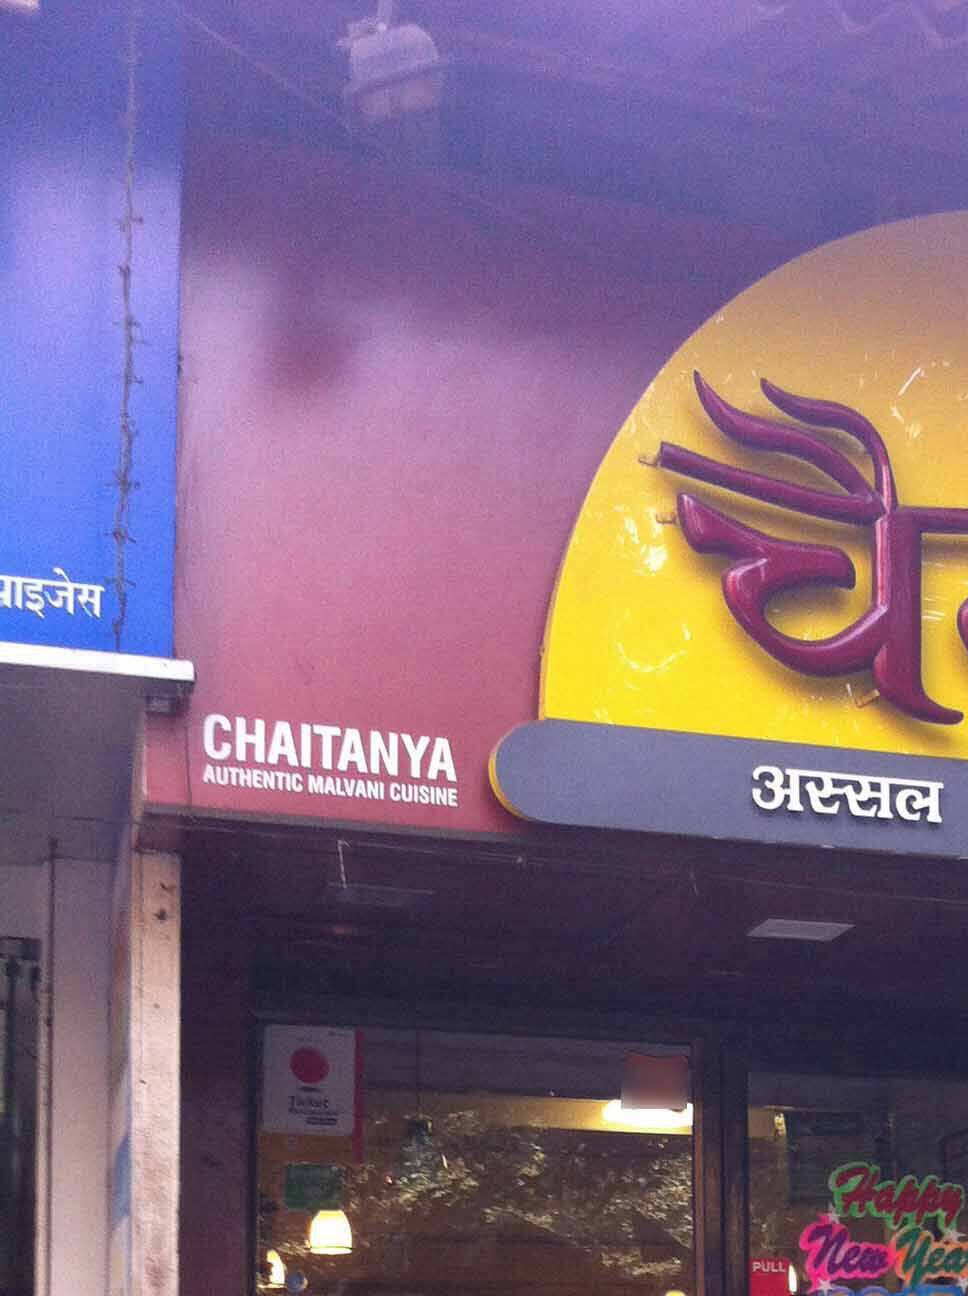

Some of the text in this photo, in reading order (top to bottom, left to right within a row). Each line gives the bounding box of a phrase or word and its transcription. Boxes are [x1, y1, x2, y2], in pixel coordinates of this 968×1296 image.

[202, 712, 458, 783] CHAITANYA
[202, 764, 458, 806] AUTHENTIC MALVANI CUISINE
[752, 765, 944, 824] अस्सल
[829, 1161, 967, 1240] Happy
[752, 1262, 787, 1273] PULL
[803, 1220, 893, 1280] New
